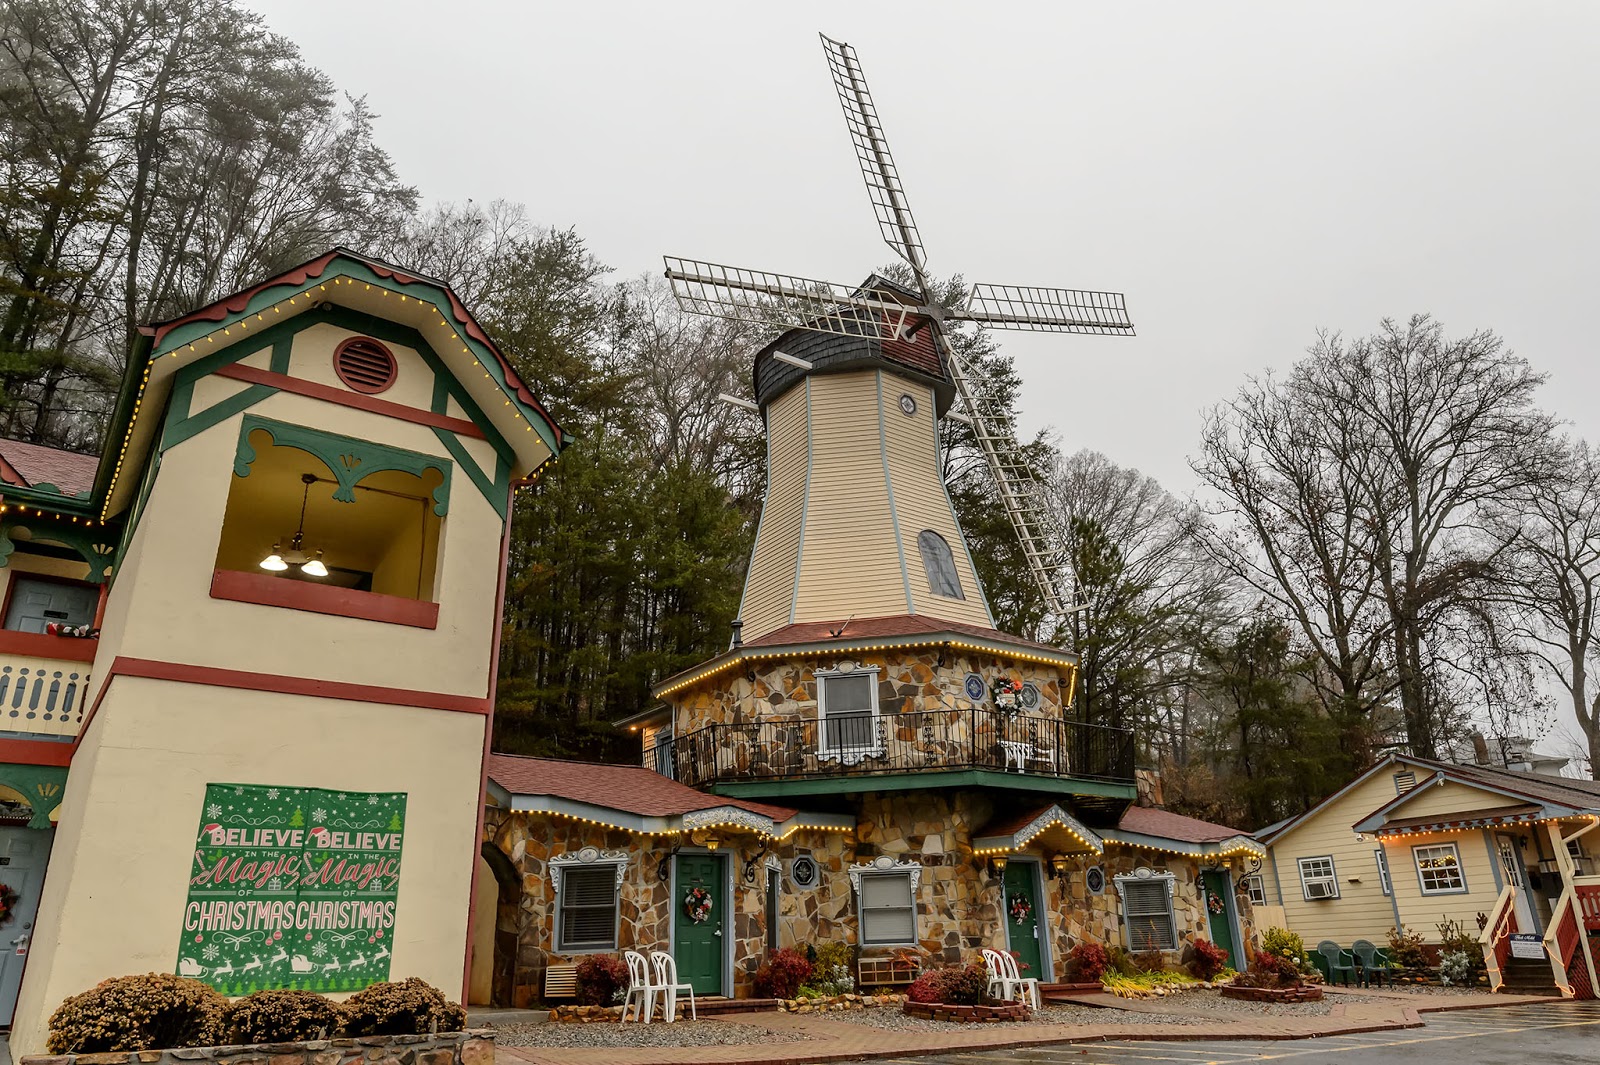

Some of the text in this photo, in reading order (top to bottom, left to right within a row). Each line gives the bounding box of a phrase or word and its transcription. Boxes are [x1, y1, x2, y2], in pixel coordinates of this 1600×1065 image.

[210, 828, 304, 847] BELIEVE
[316, 831, 402, 850] BELIEVE
[244, 850, 257, 858] IN
[190, 854, 302, 888] Magic
[300, 856, 401, 890] Magic
[237, 889, 253, 897] OF
[342, 889, 357, 897] OF
[185, 900, 296, 931] CHRISTMAS
[295, 900, 395, 930] CHRISTMAS
